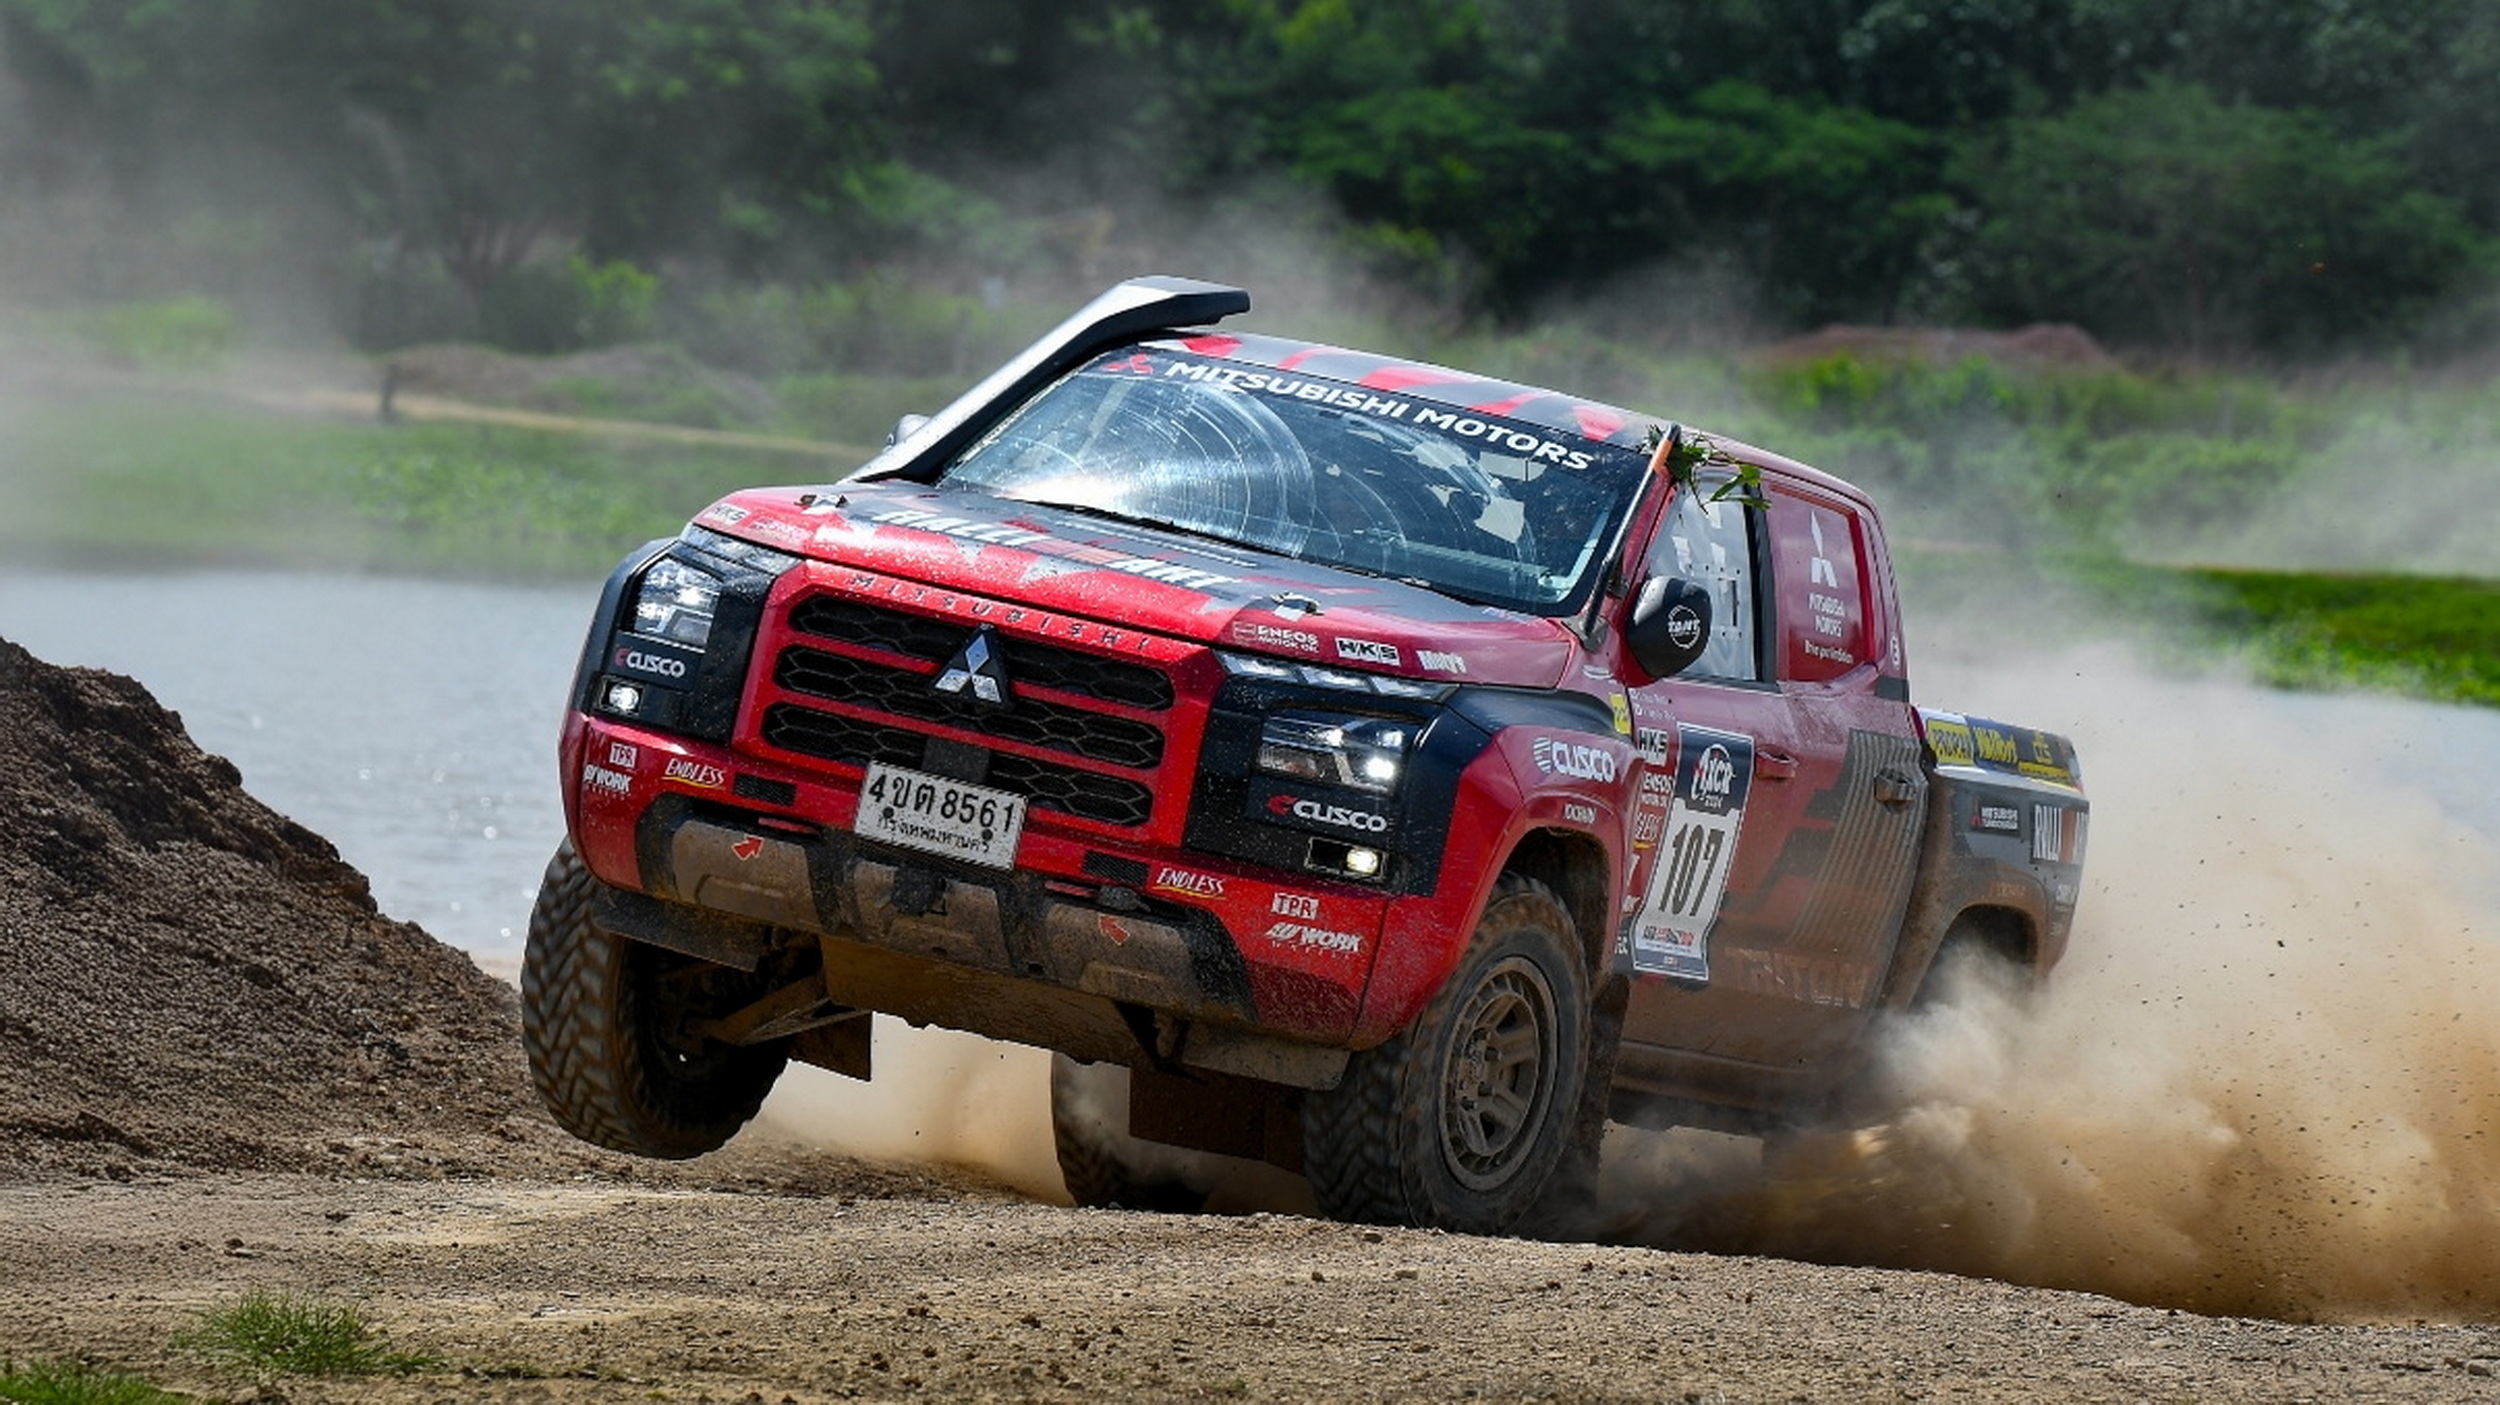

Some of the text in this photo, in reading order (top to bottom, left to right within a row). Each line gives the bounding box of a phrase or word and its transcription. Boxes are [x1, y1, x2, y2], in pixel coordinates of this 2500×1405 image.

[1163, 361, 1597, 471] MITSUBISHI MOTORS
[850, 572, 1151, 651] MITSUBISHI
[1257, 624, 1320, 647] ENEOS
[1337, 639, 1399, 661] HKS
[626, 651, 686, 679] CUSCO
[1638, 728, 1668, 754] HKS
[664, 758, 725, 786] ENDLESS
[1551, 740, 1616, 784] CUSCO
[596, 767, 633, 793] WORK
[940, 788, 1015, 833] 8561
[1292, 800, 1388, 832] CUSCO
[1155, 867, 1225, 896] ENDLESS
[1656, 822, 1727, 918] 107
[1276, 894, 1313, 917] TPR
[1300, 926, 1363, 953] WORK
